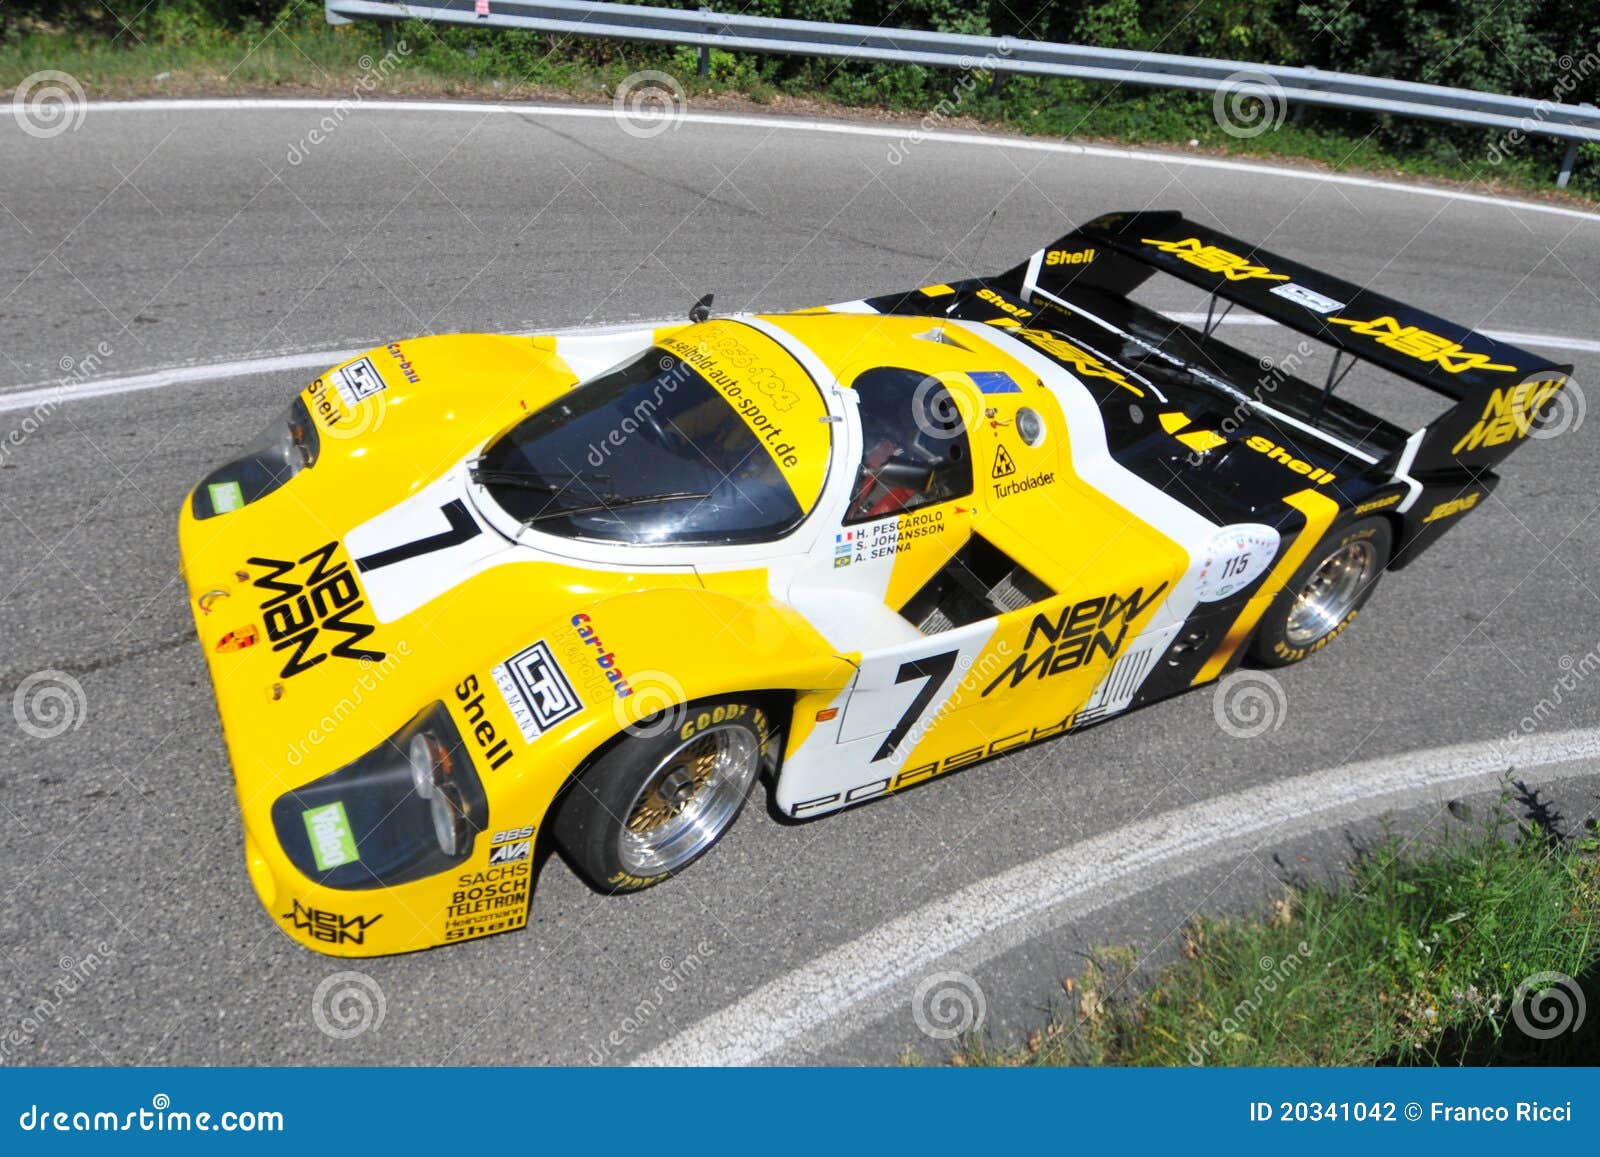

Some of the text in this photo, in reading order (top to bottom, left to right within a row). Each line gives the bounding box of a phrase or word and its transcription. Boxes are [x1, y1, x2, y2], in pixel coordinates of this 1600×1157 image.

[1046, 249, 1095, 266] Shell
[976, 288, 1033, 318] Shell
[307, 379, 342, 427] Shell
[660, 338, 799, 468] w.seibold-auto-sport.de
[1245, 435, 1336, 485] Shell
[993, 471, 1056, 499] Turbolader
[355, 498, 483, 573] 7
[855, 523, 945, 551] S. JOHANSSON
[856, 511, 943, 540] H. PESCAROLO
[855, 543, 912, 563] A. SENNA
[1221, 552, 1252, 580] 115
[570, 613, 634, 699] Car-bau
[491, 664, 541, 740] GERMANY
[870, 649, 960, 764] 7
[455, 674, 513, 771] Shell
[491, 826, 536, 844] BBS
[459, 863, 528, 888] SACHS
[447, 892, 525, 918] TELETRON
[452, 878, 527, 904] BOSCH
[445, 906, 523, 930] Heinzmann
[445, 916, 523, 941] Shell
